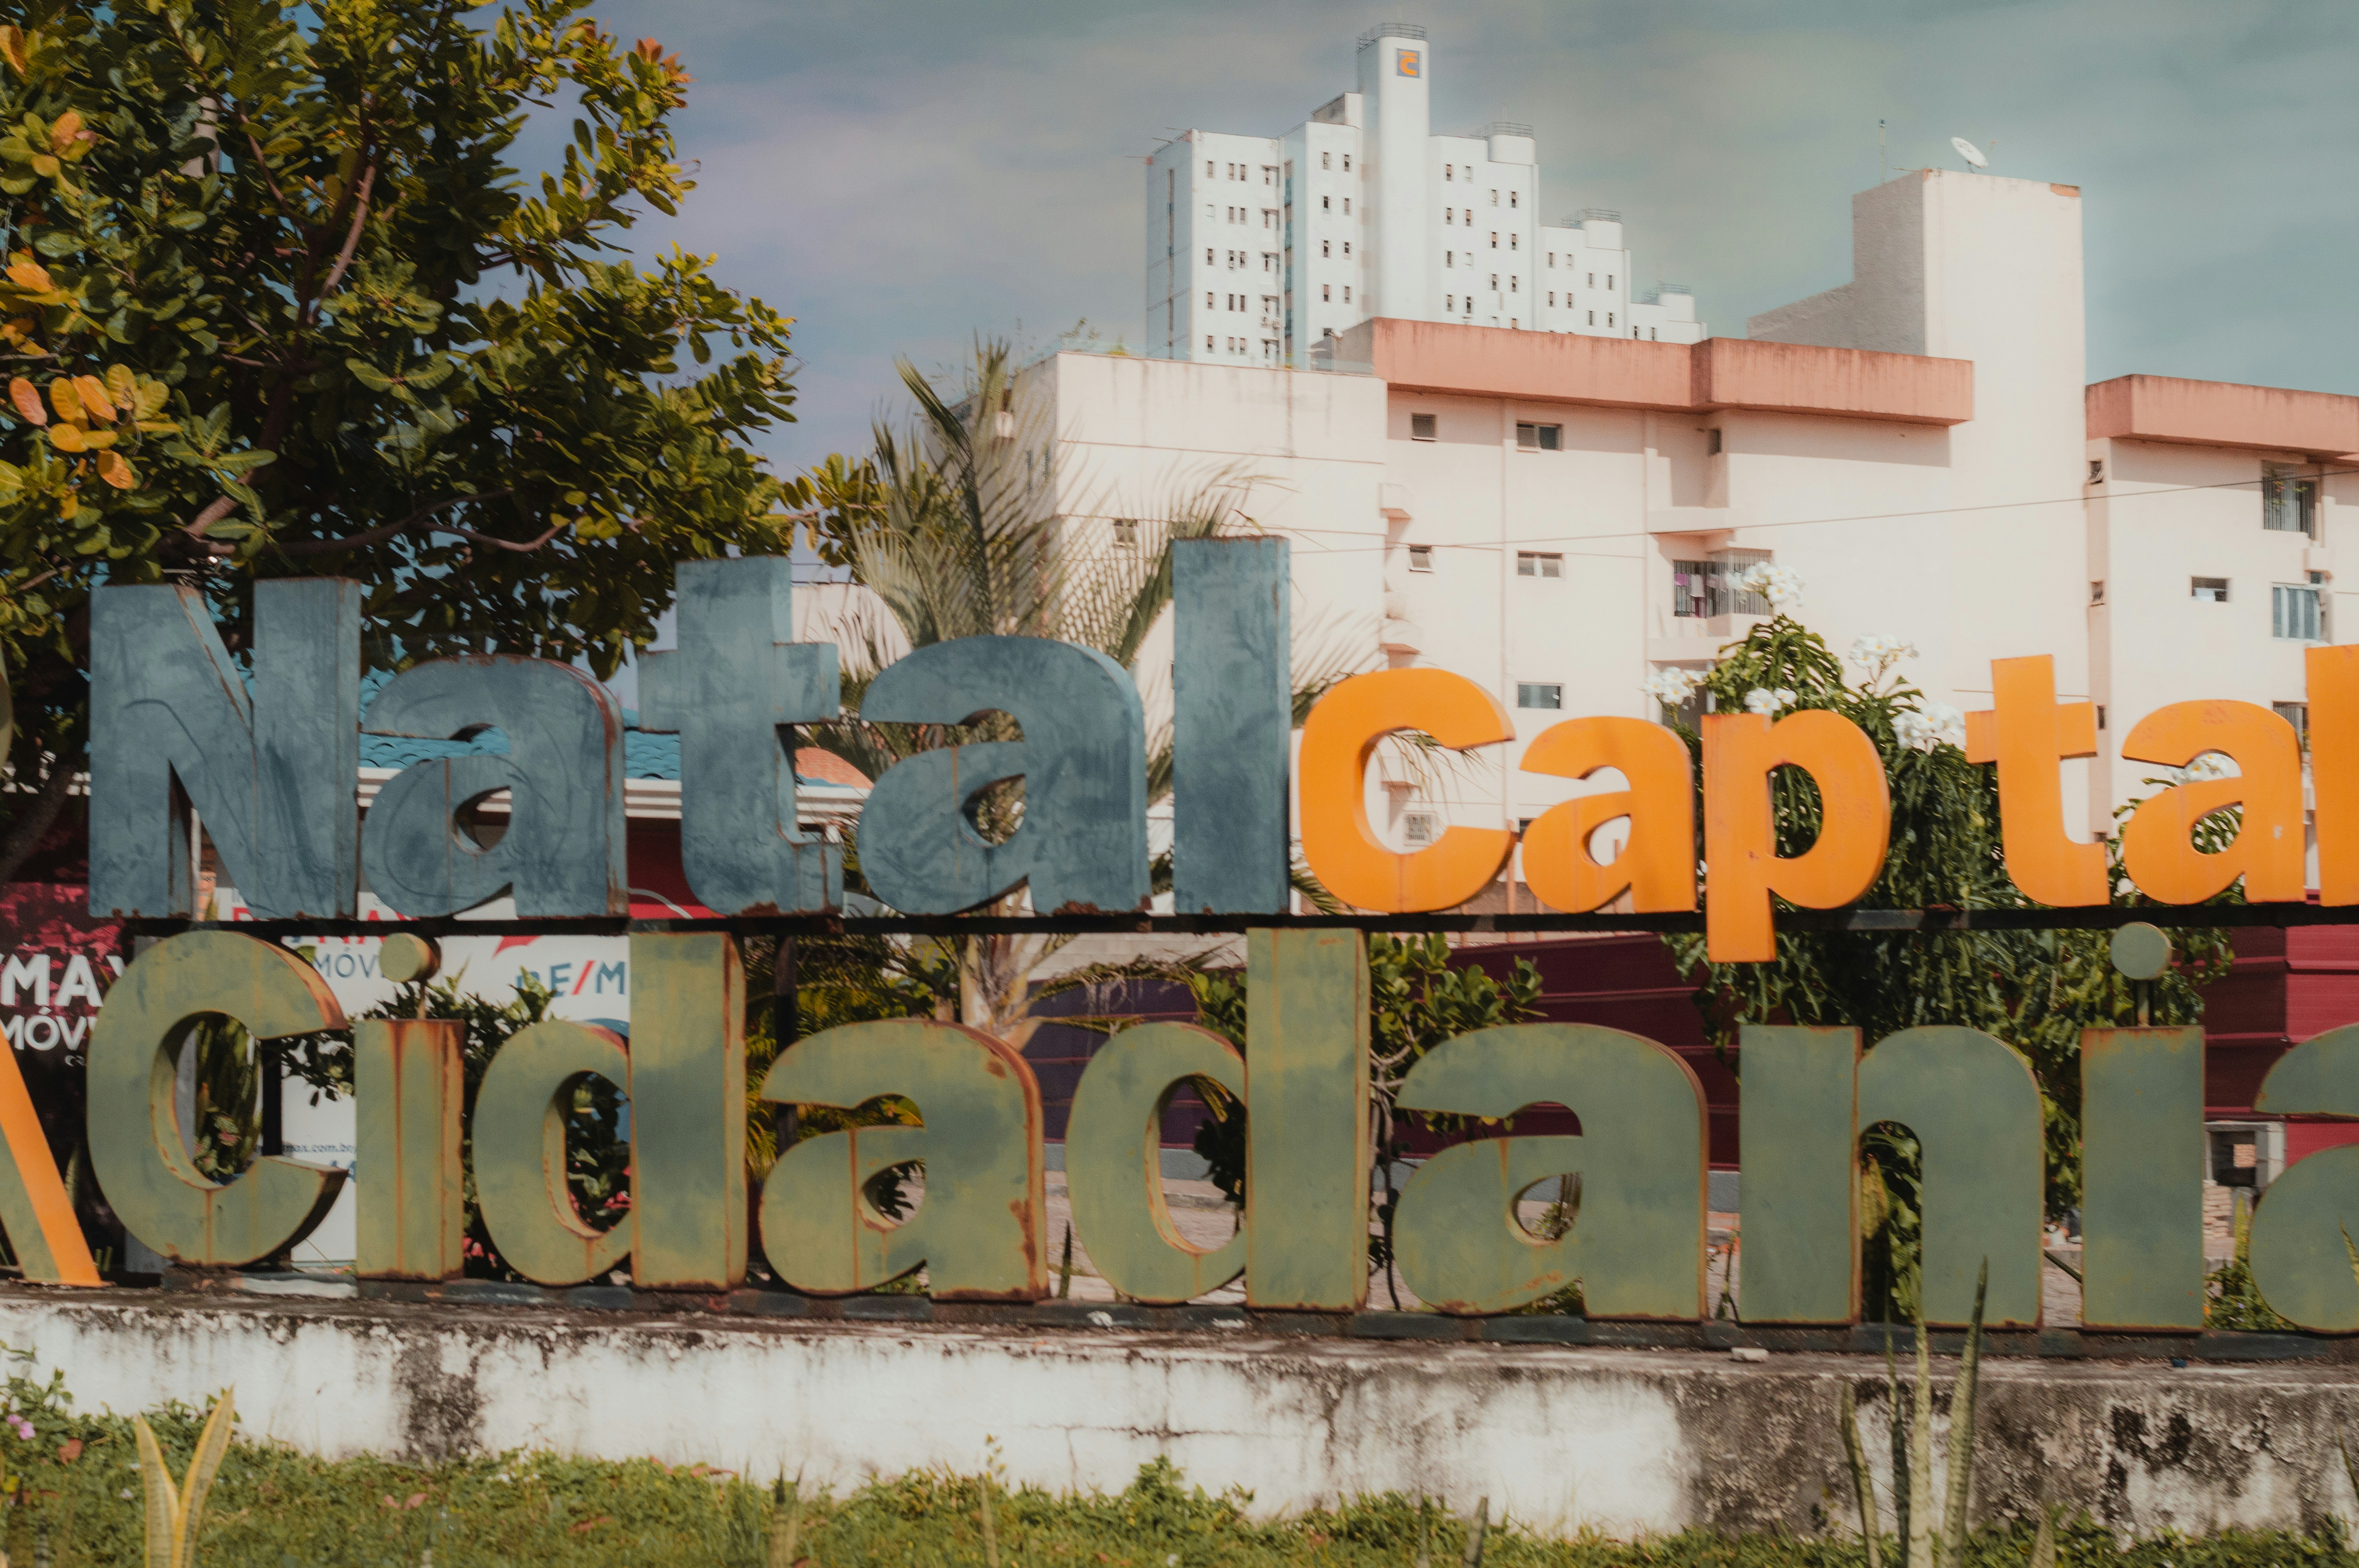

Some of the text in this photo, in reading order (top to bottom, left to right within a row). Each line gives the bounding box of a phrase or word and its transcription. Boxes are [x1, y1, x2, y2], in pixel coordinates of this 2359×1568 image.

[88, 535, 1291, 920] Natal
[0, 953, 127, 1007] MA
[314, 946, 386, 979] MÓV
[0, 1005, 98, 1051] MÓV
